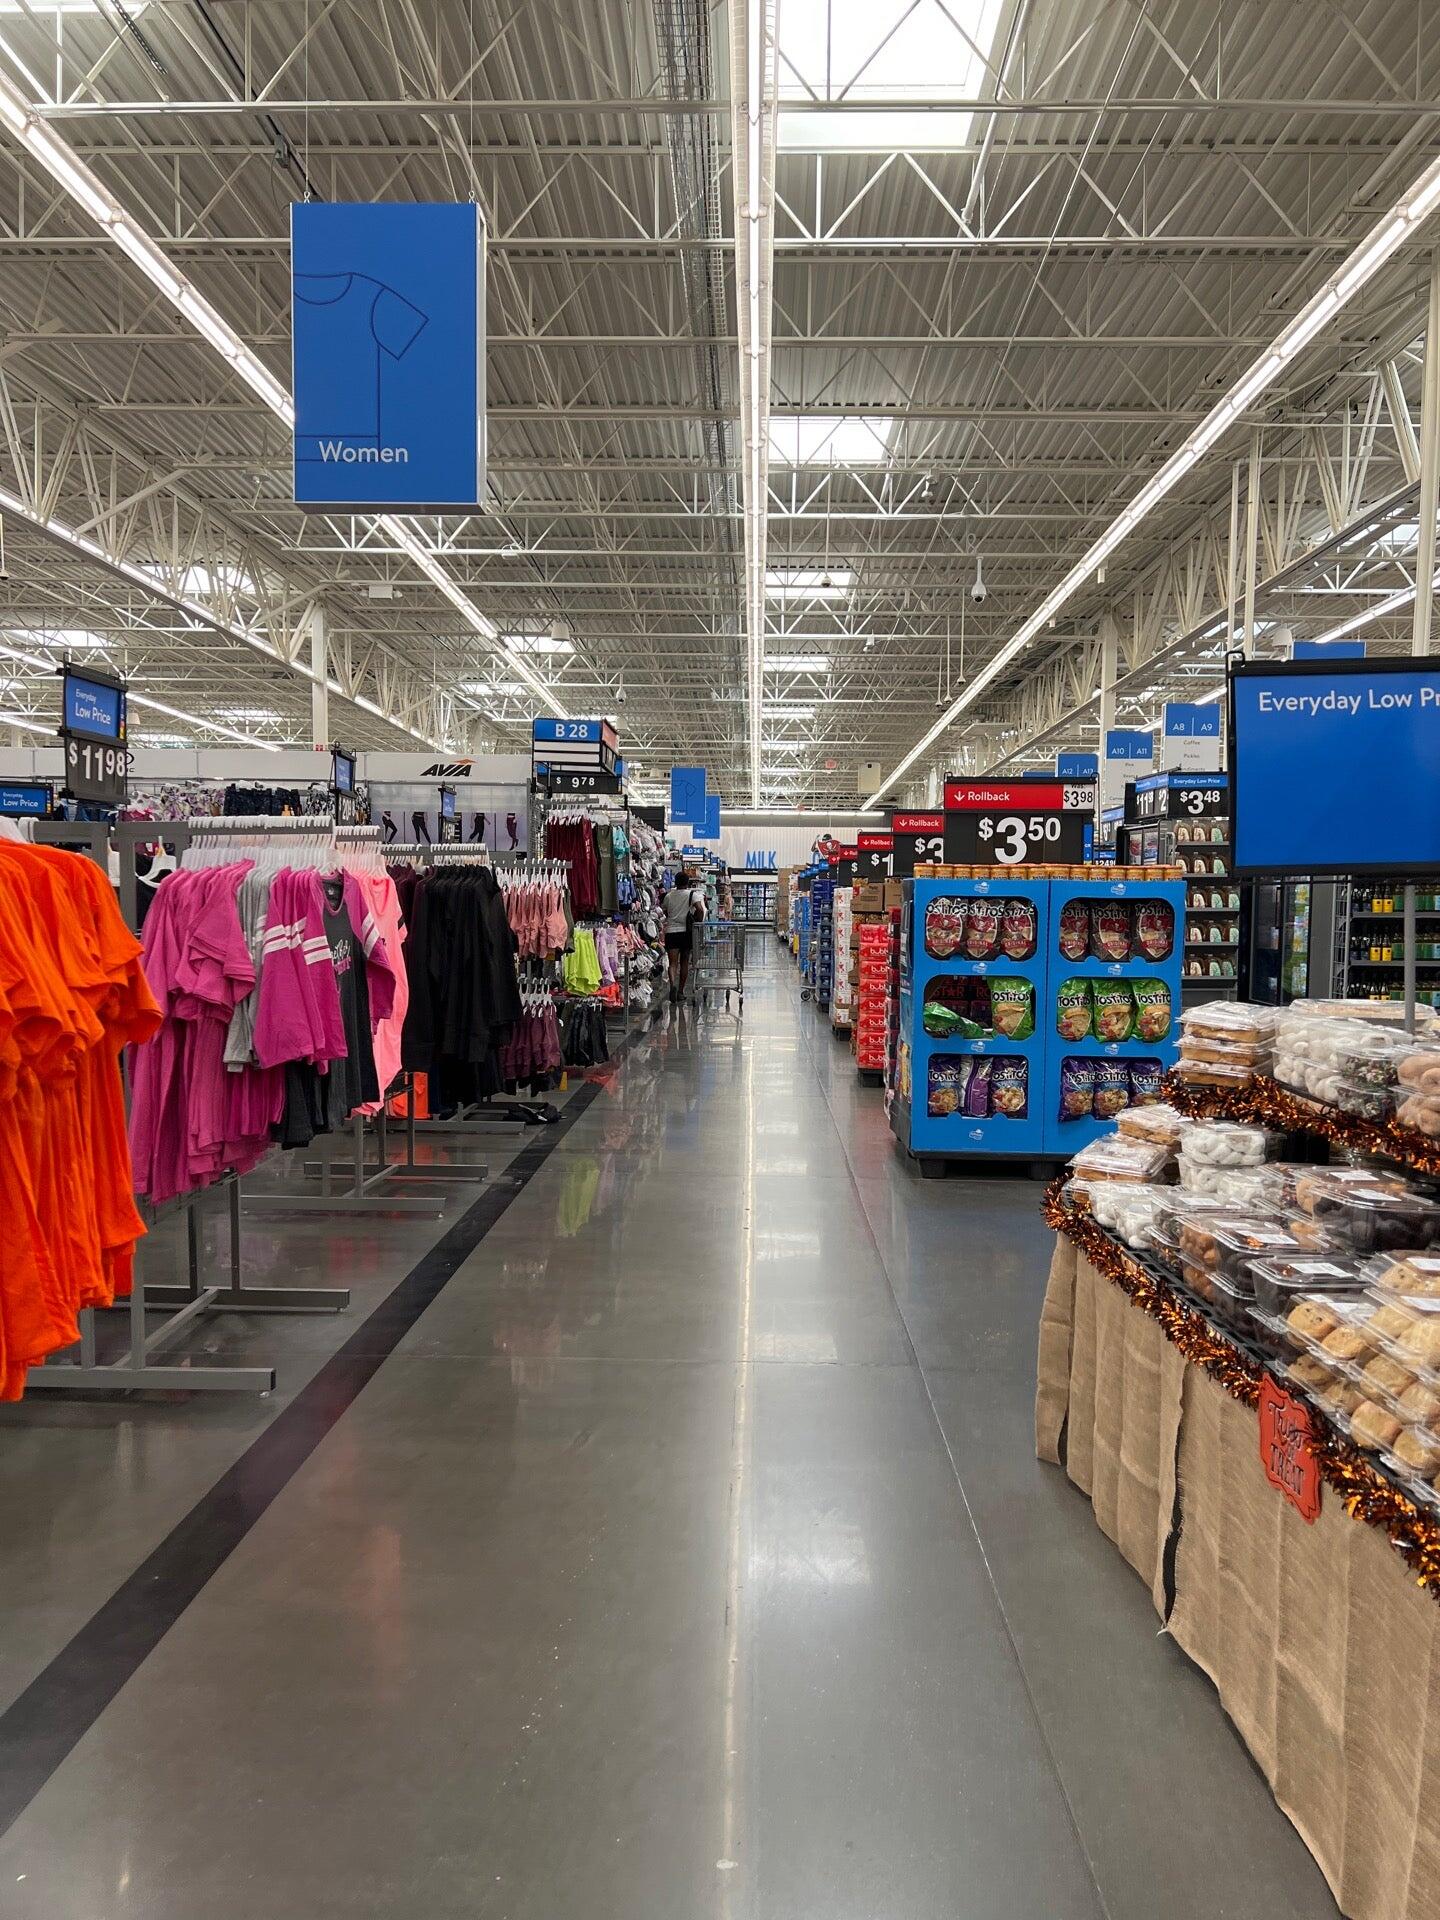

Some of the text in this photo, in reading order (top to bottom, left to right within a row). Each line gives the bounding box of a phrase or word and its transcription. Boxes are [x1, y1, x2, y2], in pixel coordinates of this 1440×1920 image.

[319, 441, 409, 462] Women
[75, 688, 97, 704] Everyday
[1259, 690, 1362, 716] Everyday
[1369, 689, 1412, 708] Low
[75, 702, 111, 724] Low Price
[1173, 723, 1213, 731] A8 A9
[420, 763, 472, 777] AVIA
[20, 799, 39, 807] Price
[967, 791, 1010, 801] Rollback
[909, 819, 939, 827] Rollback
[745, 851, 777, 869] MILK
[1137, 992, 1171, 1004] TOSTITO
